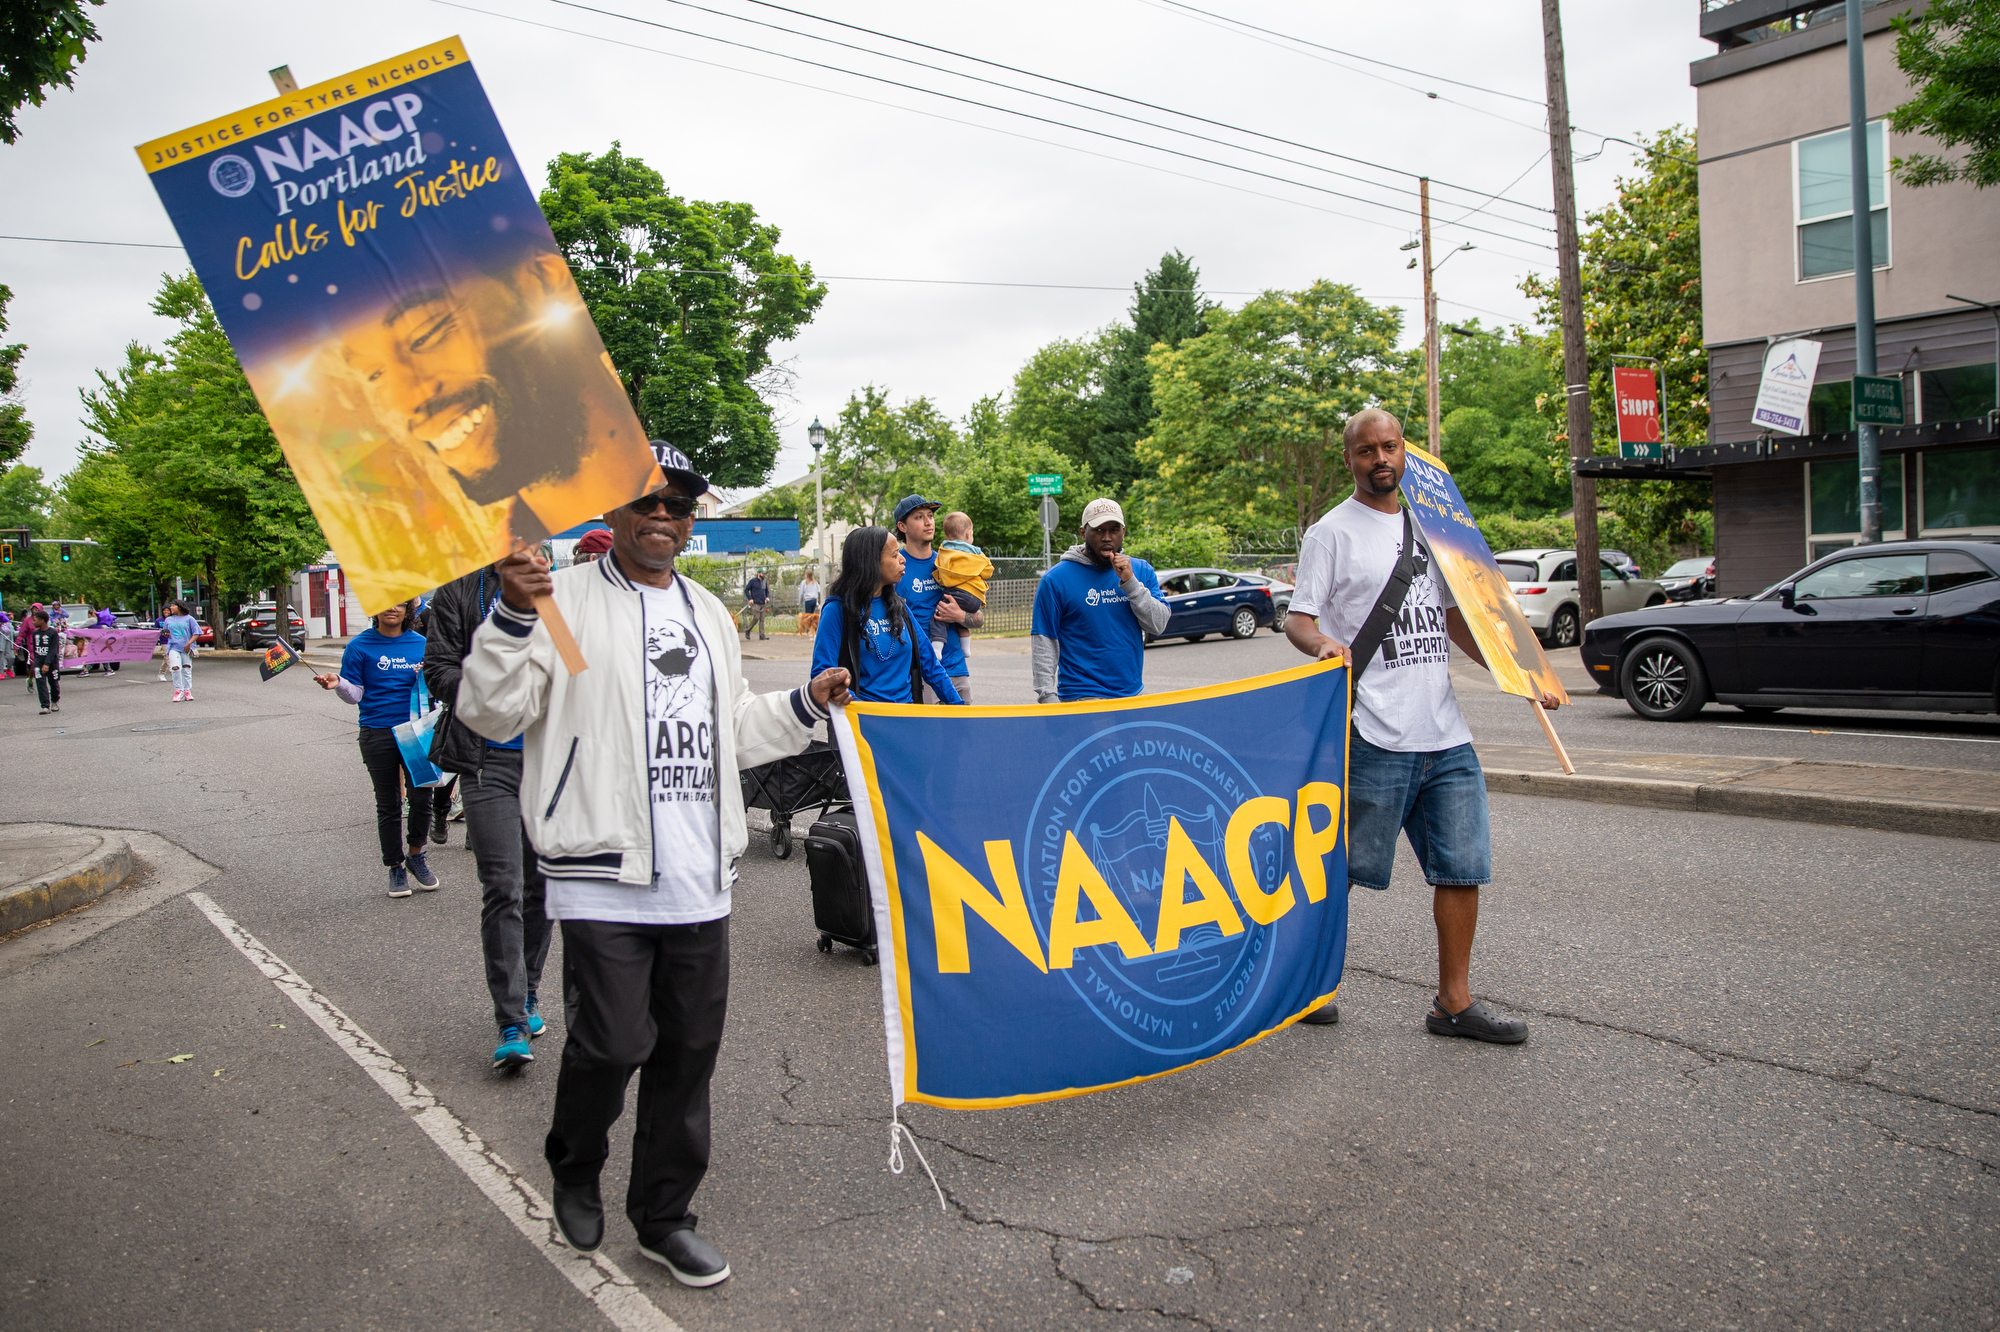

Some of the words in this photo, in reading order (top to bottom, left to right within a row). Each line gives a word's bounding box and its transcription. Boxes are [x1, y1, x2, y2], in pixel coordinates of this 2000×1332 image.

[154, 123, 244, 164] JUSTICE
[254, 106, 296, 128] FOR
[305, 84, 358, 110] TYRE
[367, 50, 456, 88] NICHOLS
[253, 93, 423, 183] NAACP
[273, 131, 428, 216] Portland
[235, 218, 330, 280] Calls
[337, 200, 385, 247] for
[394, 156, 501, 218] Justice
[1621, 398, 1655, 416] SHOPP
[1864, 383, 1894, 400] MORRIS
[1857, 403, 1875, 417] NEXT
[1405, 456, 1445, 488] NAACP
[1413, 472, 1452, 503] Portland
[1410, 484, 1436, 511] Calls
[1102, 594, 1130, 604] involve
[1400, 639, 1412, 650] ON
[1385, 656, 1432, 669] FOLLOWING
[1434, 655, 1446, 663] THE
[1089, 744, 1127, 773] THE
[1132, 740, 1249, 805] ADVANCEMEN
[1060, 768, 1093, 806] FOR
[915, 781, 1342, 975] NAACP
[1085, 966, 1173, 1037] NATIONAL
[1214, 958, 1256, 1022] PEOPLE
